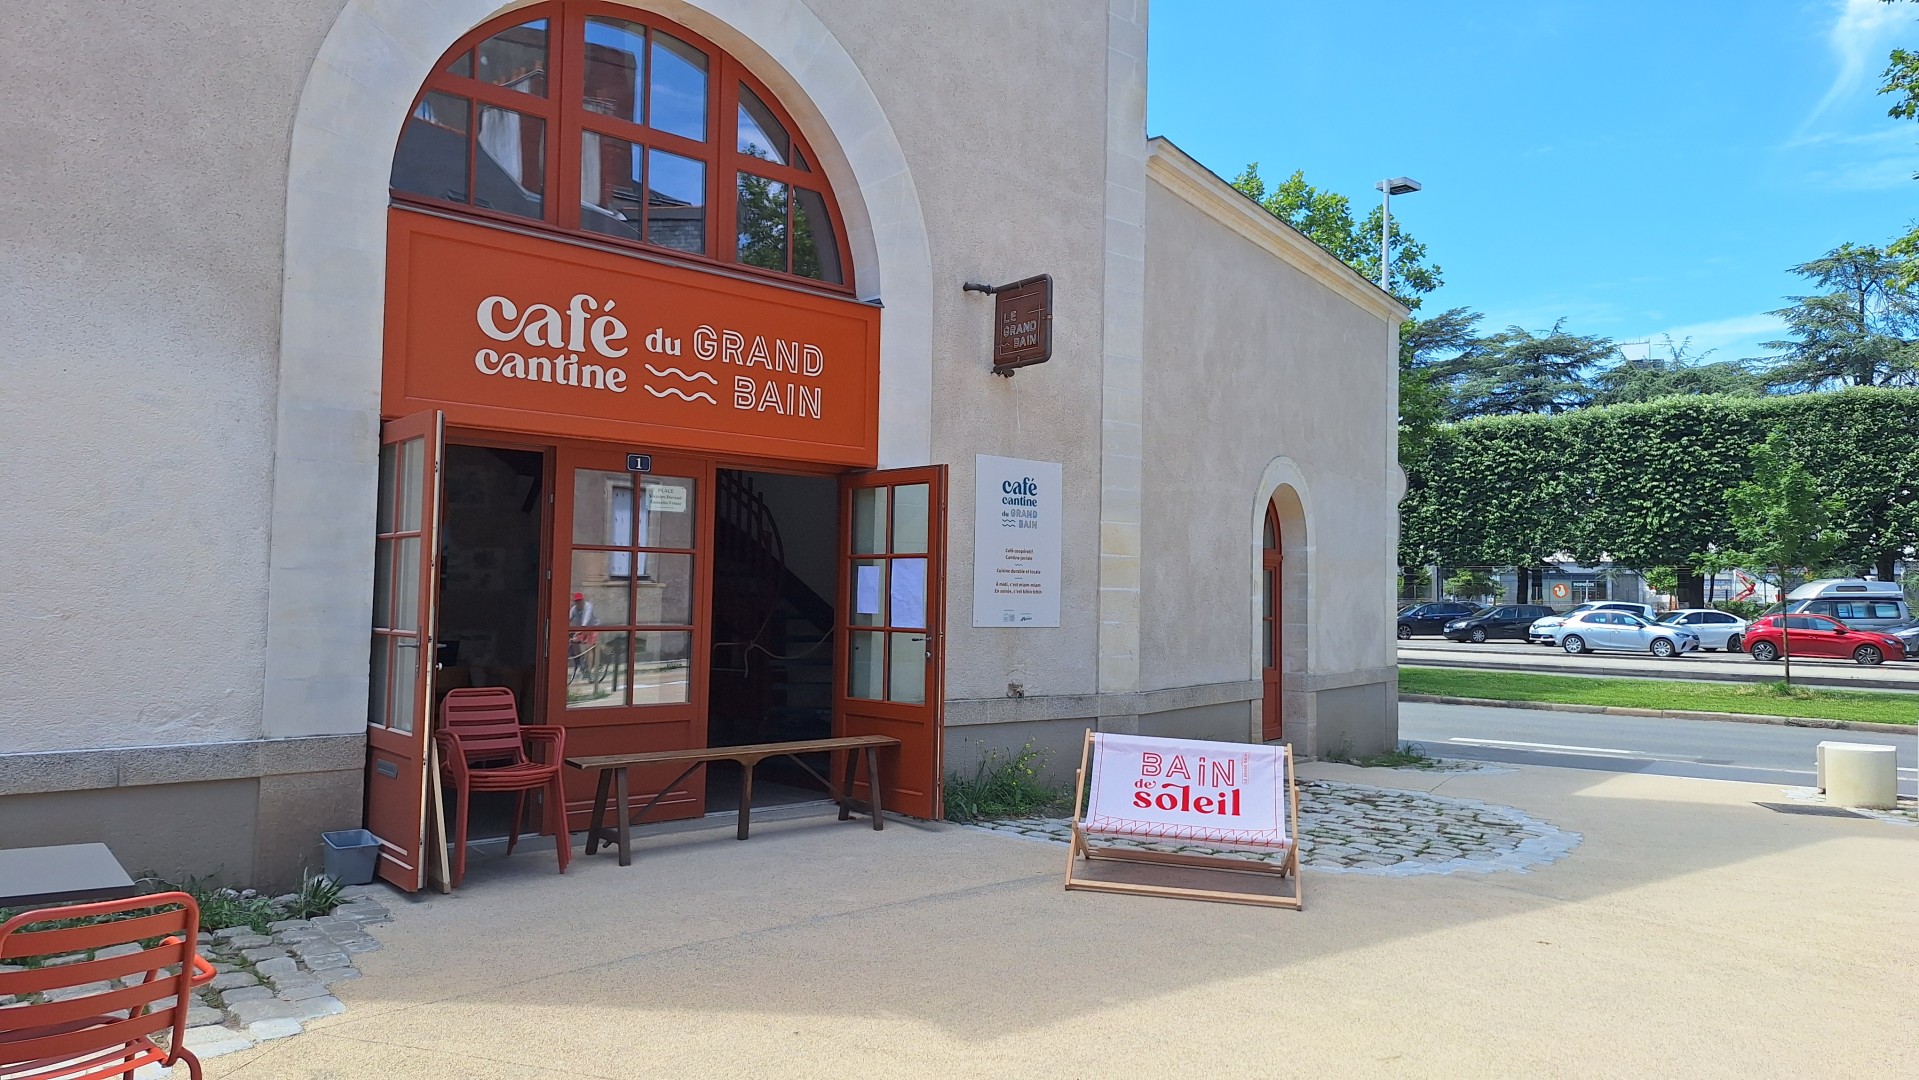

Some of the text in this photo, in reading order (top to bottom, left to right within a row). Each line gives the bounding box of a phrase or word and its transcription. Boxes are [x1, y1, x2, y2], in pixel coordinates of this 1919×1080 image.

[476, 293, 629, 358] café
[1003, 310, 1017, 324] LE
[1003, 320, 1037, 338] GRAND
[1013, 333, 1037, 349] BAIN
[645, 324, 824, 377] du GRAND
[475, 348, 628, 393] cantine
[734, 375, 822, 419] BAIN
[635, 457, 643, 469] 1
[1002, 476, 1038, 497] café
[1002, 496, 1038, 507] cantine
[1010, 508, 1038, 519] GRAND
[1018, 519, 1038, 530] BAIN
[1132, 782, 1241, 817] soleil
